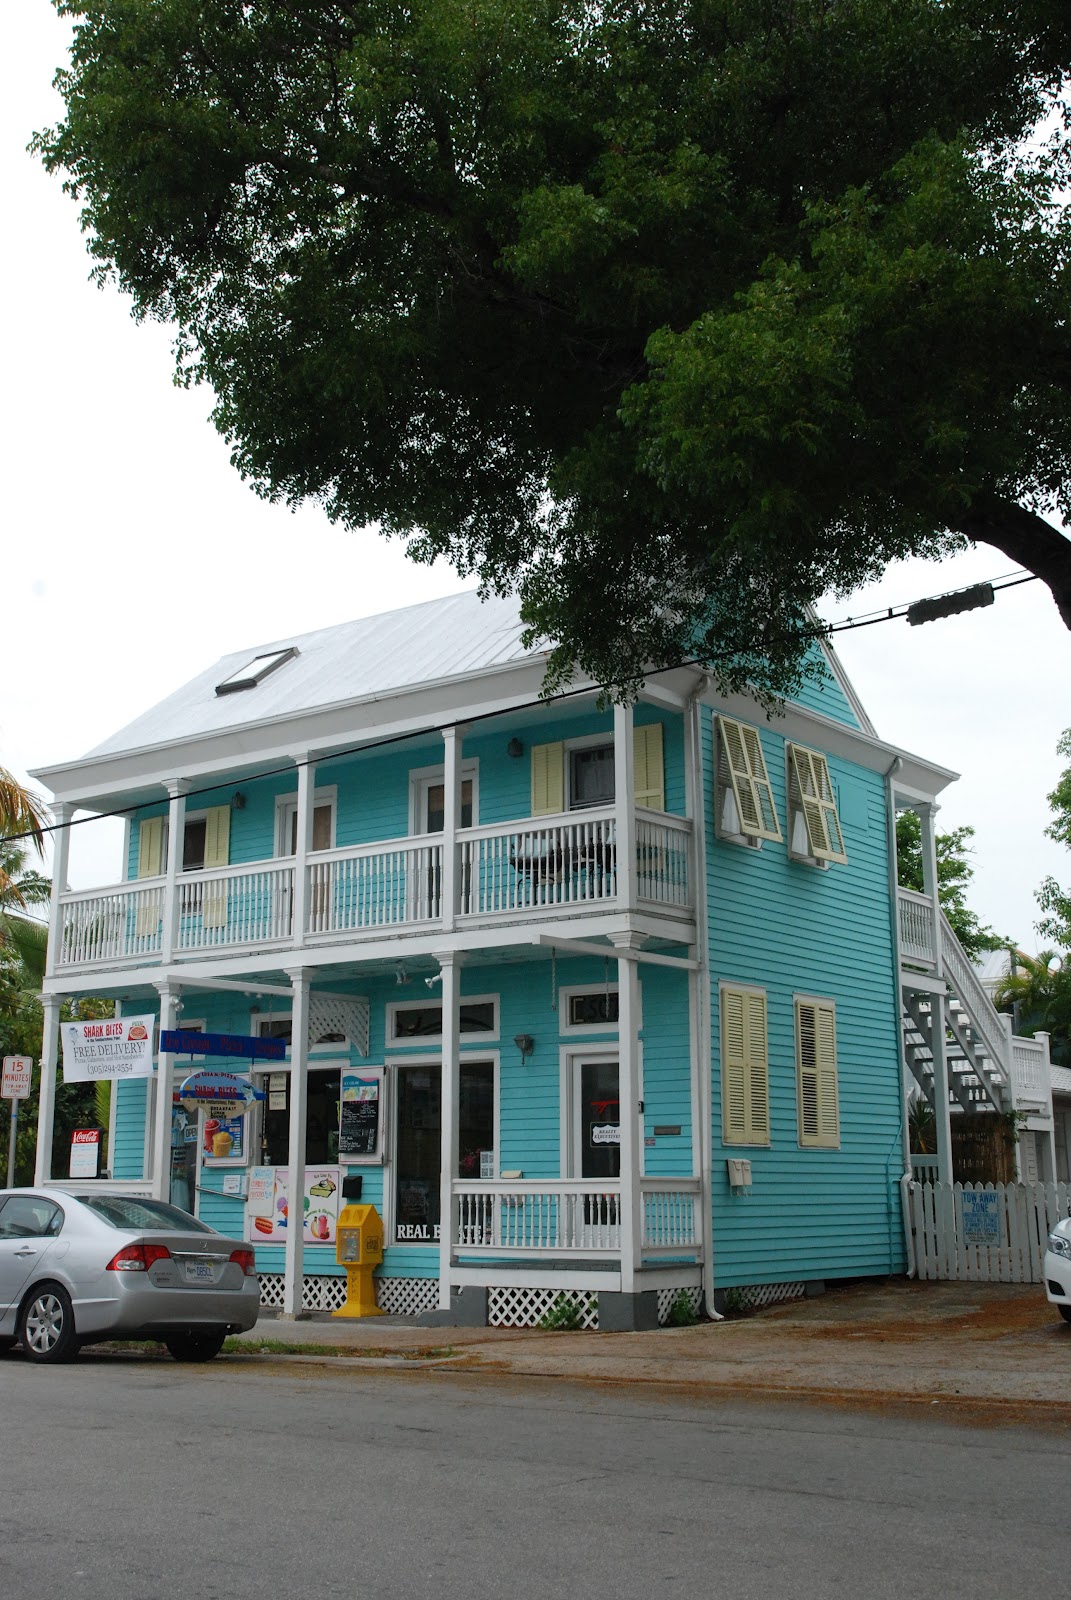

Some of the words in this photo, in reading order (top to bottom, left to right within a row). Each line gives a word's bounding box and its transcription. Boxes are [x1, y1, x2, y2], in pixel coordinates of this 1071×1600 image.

[83, 1024, 104, 1038] SHARK
[105, 1022, 123, 1037] BITES
[73, 1046, 97, 1058] FREE
[97, 1041, 146, 1056] DELIVERY!
[12, 1061, 24, 1072] 15
[87, 1063, 133, 1075] (305)294-2554
[4, 1074, 29, 1082] MINUTES
[194, 1084, 216, 1098] SHARK
[218, 1086, 238, 1099] BITES
[77, 1130, 99, 1143] Coca-Cola
[963, 1192, 977, 1203] TOW
[979, 1193, 996, 1203] AWAY
[972, 1203, 988, 1212] ZONE
[397, 1224, 430, 1239] REAL
